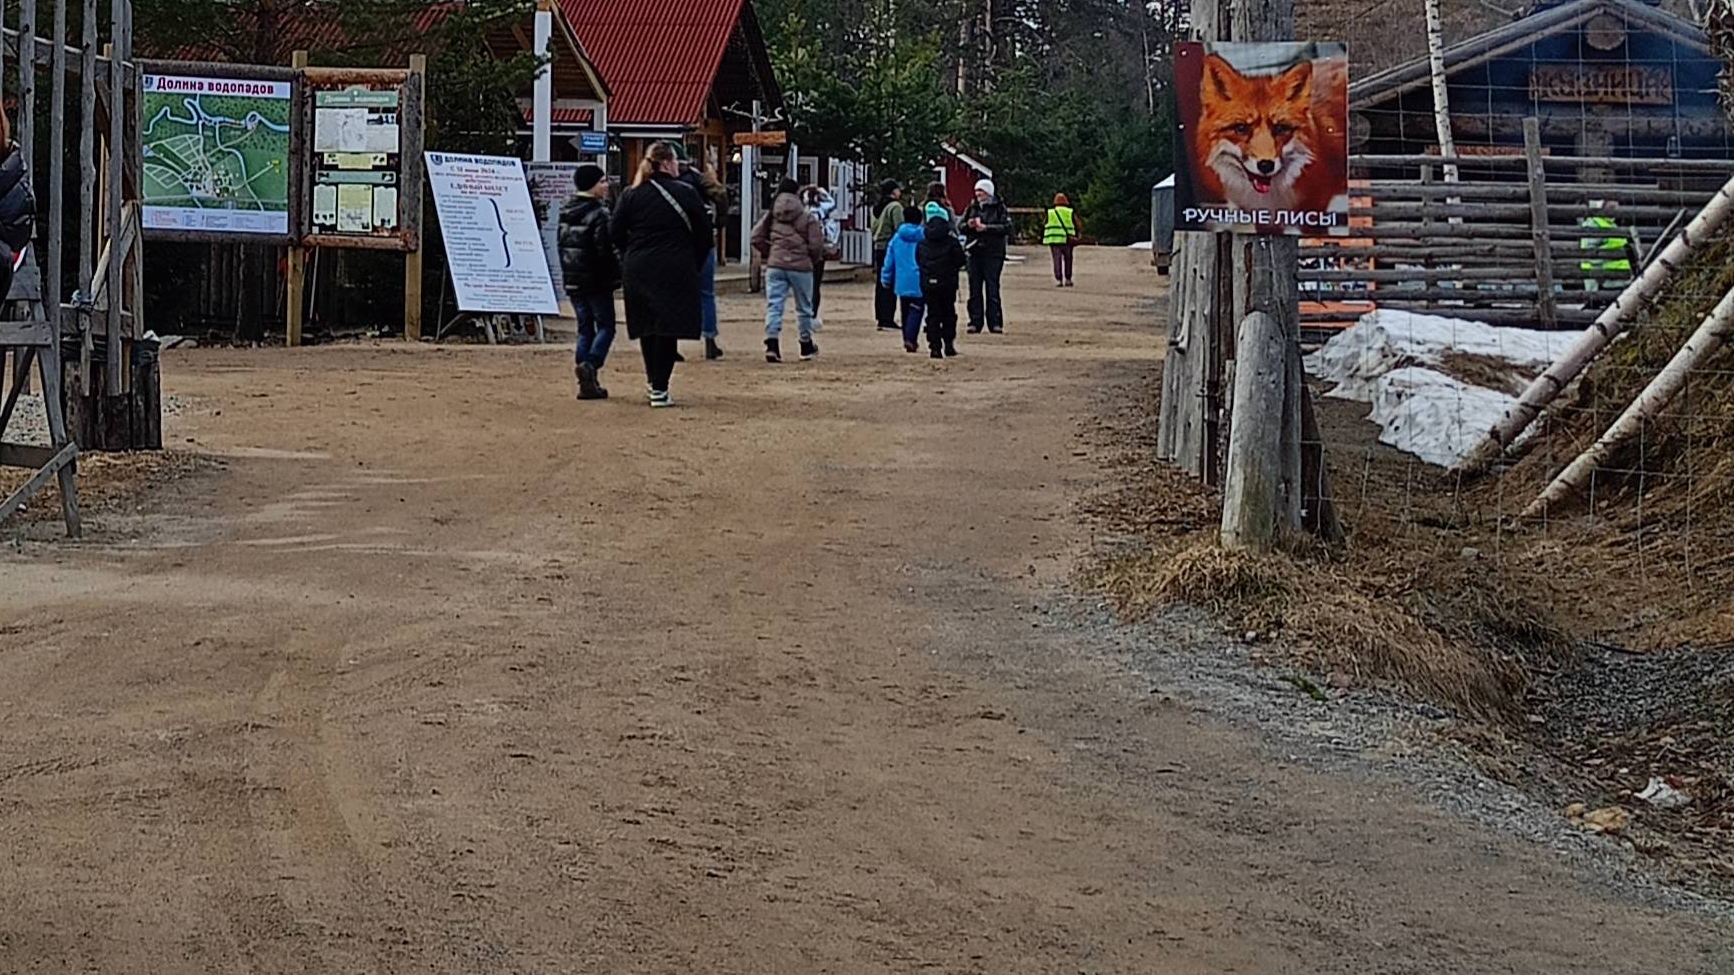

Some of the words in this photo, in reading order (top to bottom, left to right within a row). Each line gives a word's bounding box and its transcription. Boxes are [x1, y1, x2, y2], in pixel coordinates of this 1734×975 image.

[156, 77, 205, 91] Долина
[207, 82, 275, 95] водопадов
[1184, 208, 1271, 225] РУЧНЫЕ
[1274, 210, 1337, 227] ЛИСЫ
